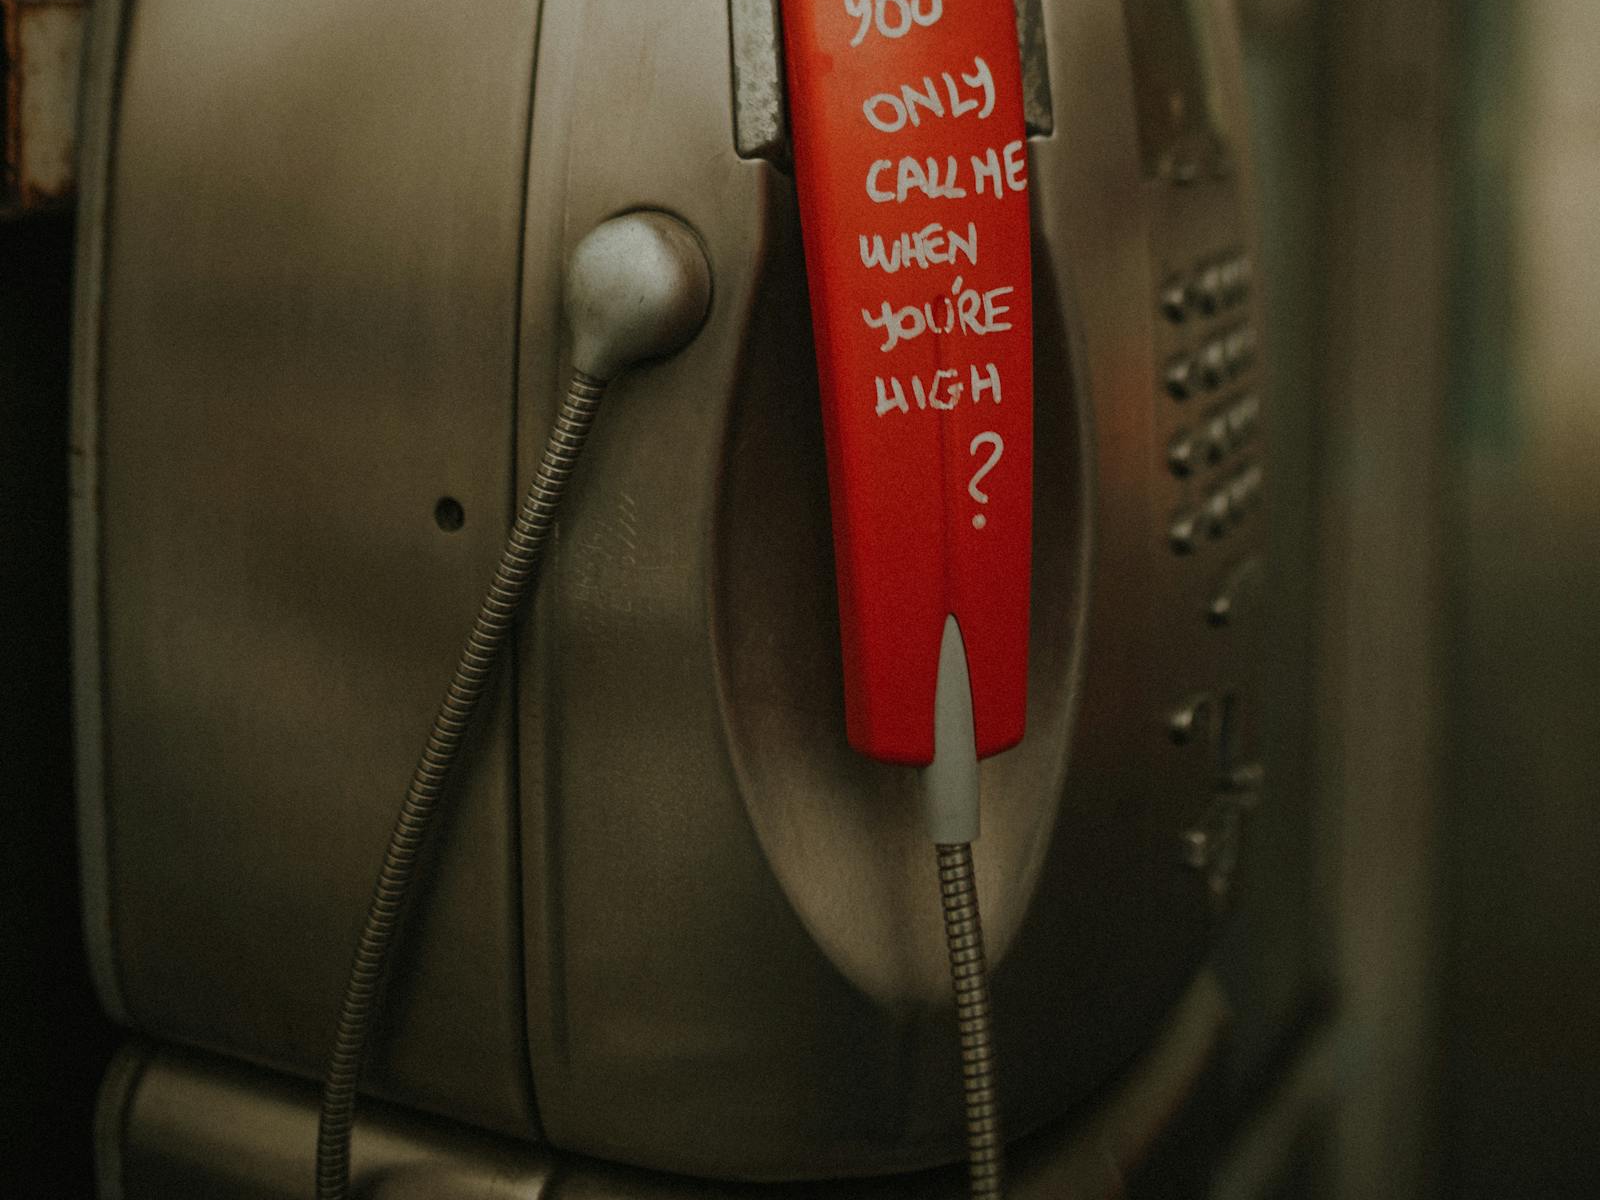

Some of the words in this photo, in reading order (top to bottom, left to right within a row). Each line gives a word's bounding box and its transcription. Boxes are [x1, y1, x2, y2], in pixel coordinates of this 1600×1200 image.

[862, 56, 996, 133] ONLY
[865, 155, 967, 203] CALL
[970, 140, 1027, 199] ME
[858, 222, 978, 273] WHEN
[861, 275, 1014, 353] YOU'RE
[875, 363, 1002, 417] HIGH
[968, 431, 1004, 527] ?
